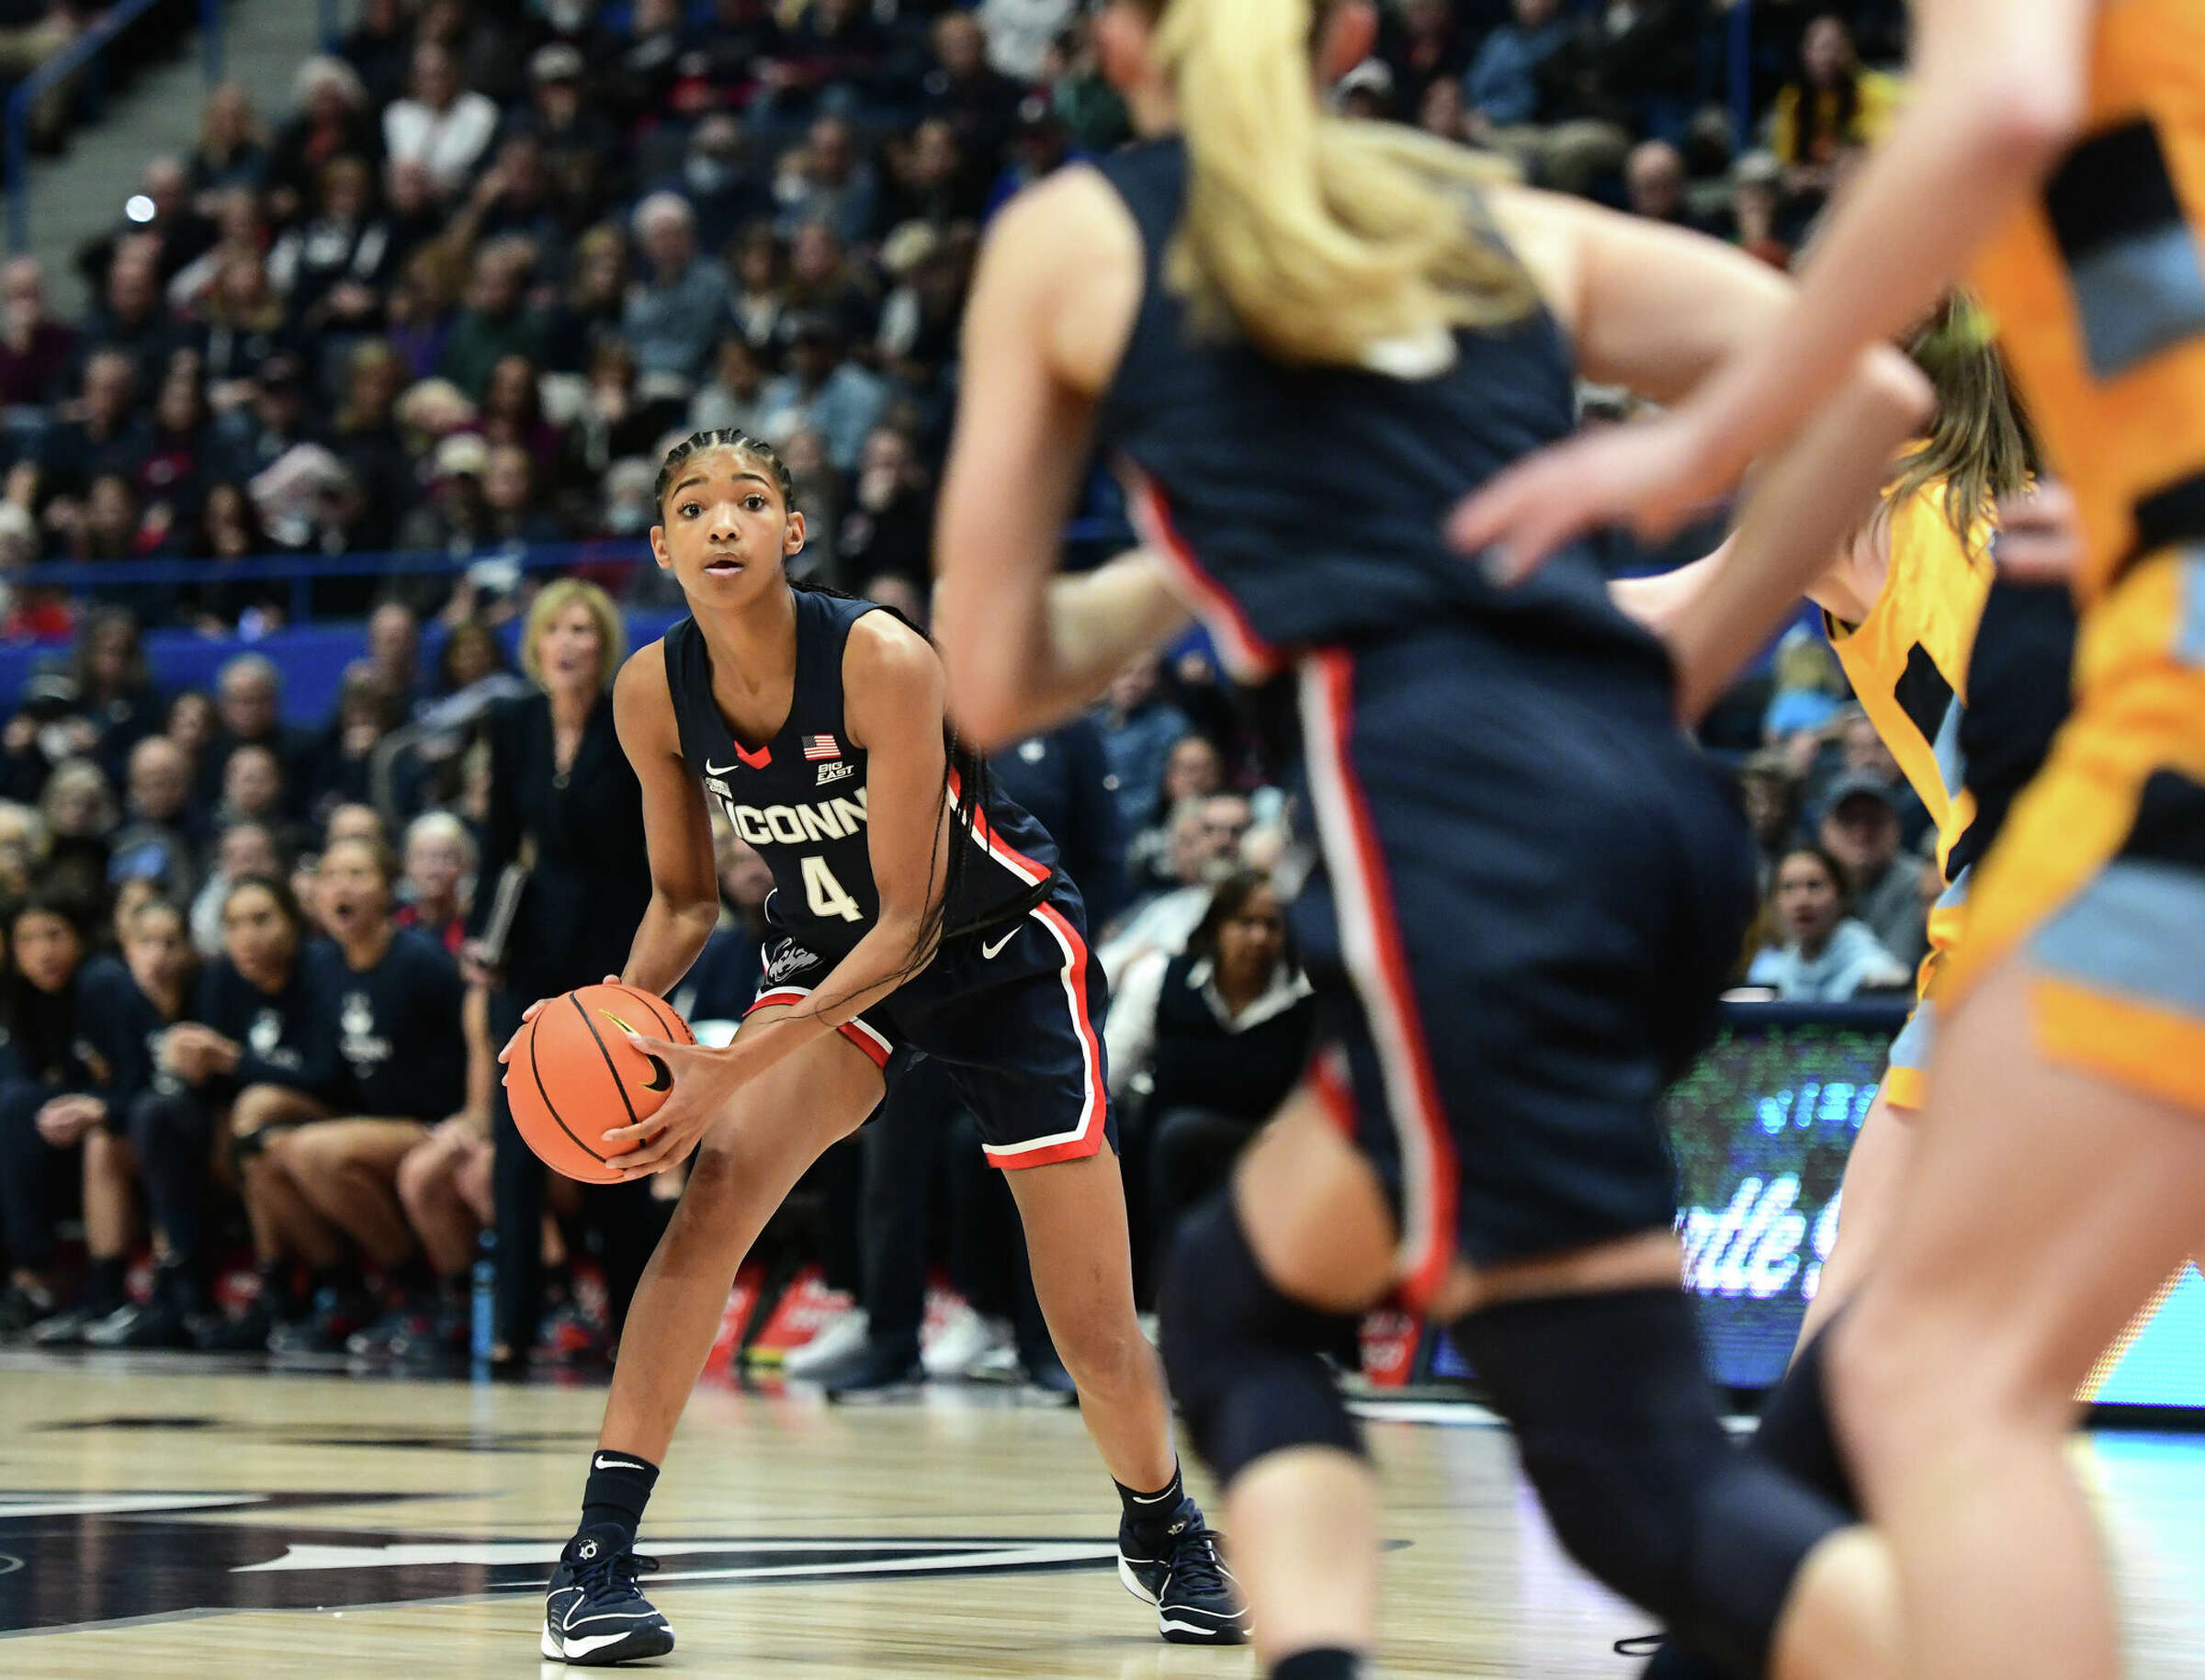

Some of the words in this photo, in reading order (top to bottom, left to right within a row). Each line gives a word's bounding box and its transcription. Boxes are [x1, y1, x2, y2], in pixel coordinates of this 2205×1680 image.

[818, 761, 842, 772] BIG
[818, 764, 854, 782] EAST
[801, 856, 864, 922] 4
